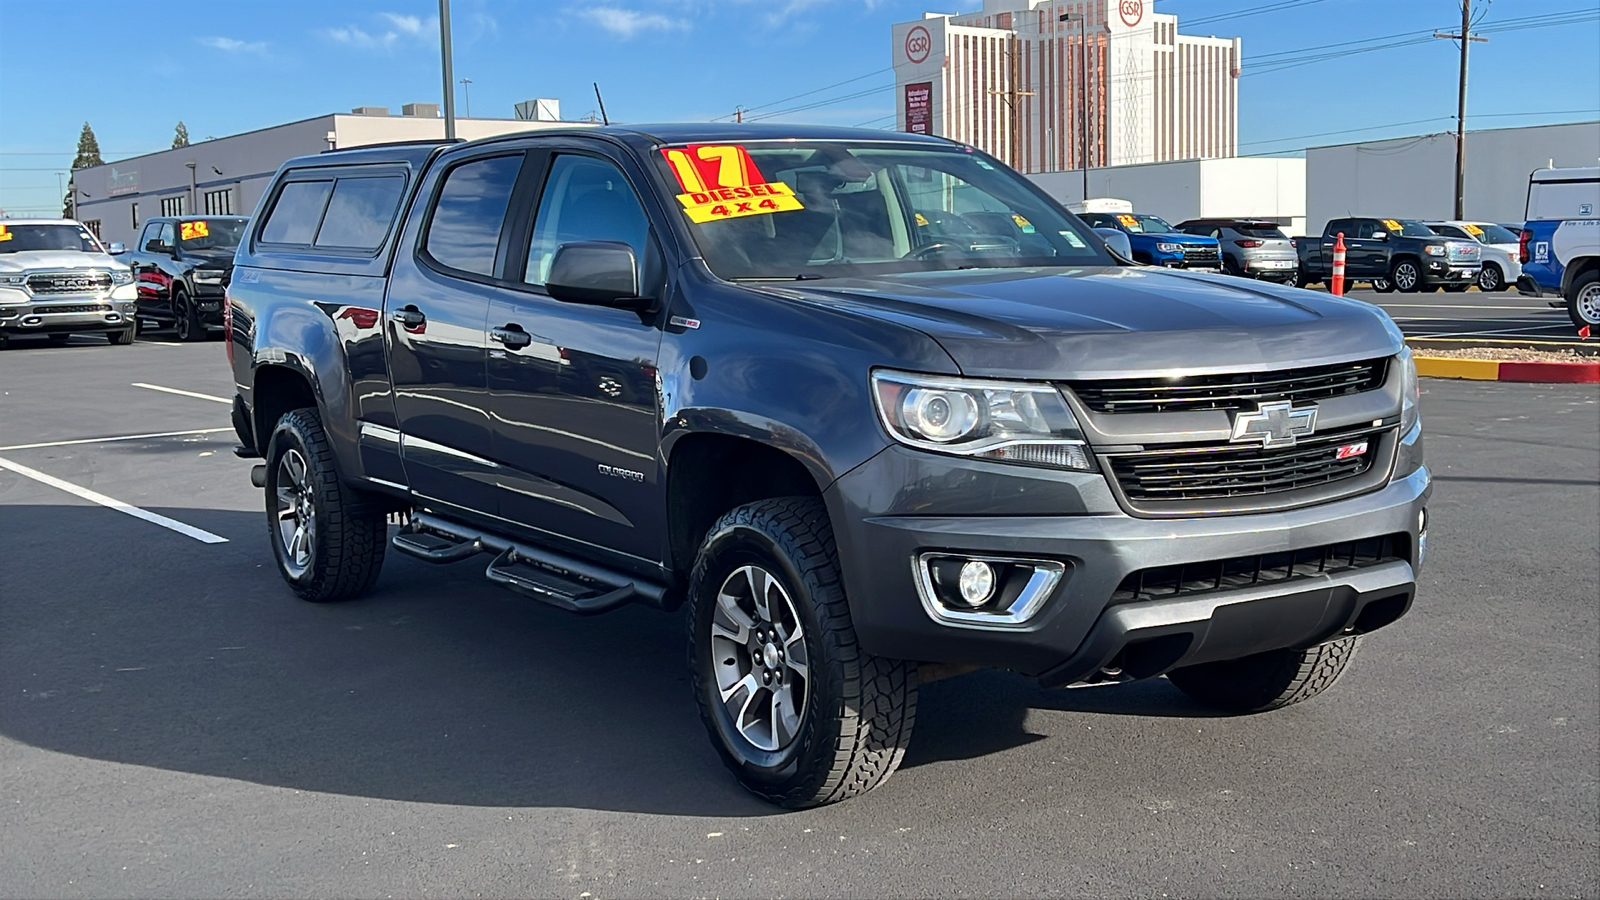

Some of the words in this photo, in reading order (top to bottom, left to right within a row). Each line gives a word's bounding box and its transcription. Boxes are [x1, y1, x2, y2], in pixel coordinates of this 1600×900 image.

[1122, 1, 1140, 16] GSR
[909, 36, 928, 53] GSR
[668, 146, 743, 192] 17
[691, 184, 781, 205] DIESEL
[181, 220, 206, 234] 20
[53, 279, 90, 287] RAM
[1336, 443, 1368, 459] Z71
[598, 464, 644, 482] COLORADO
